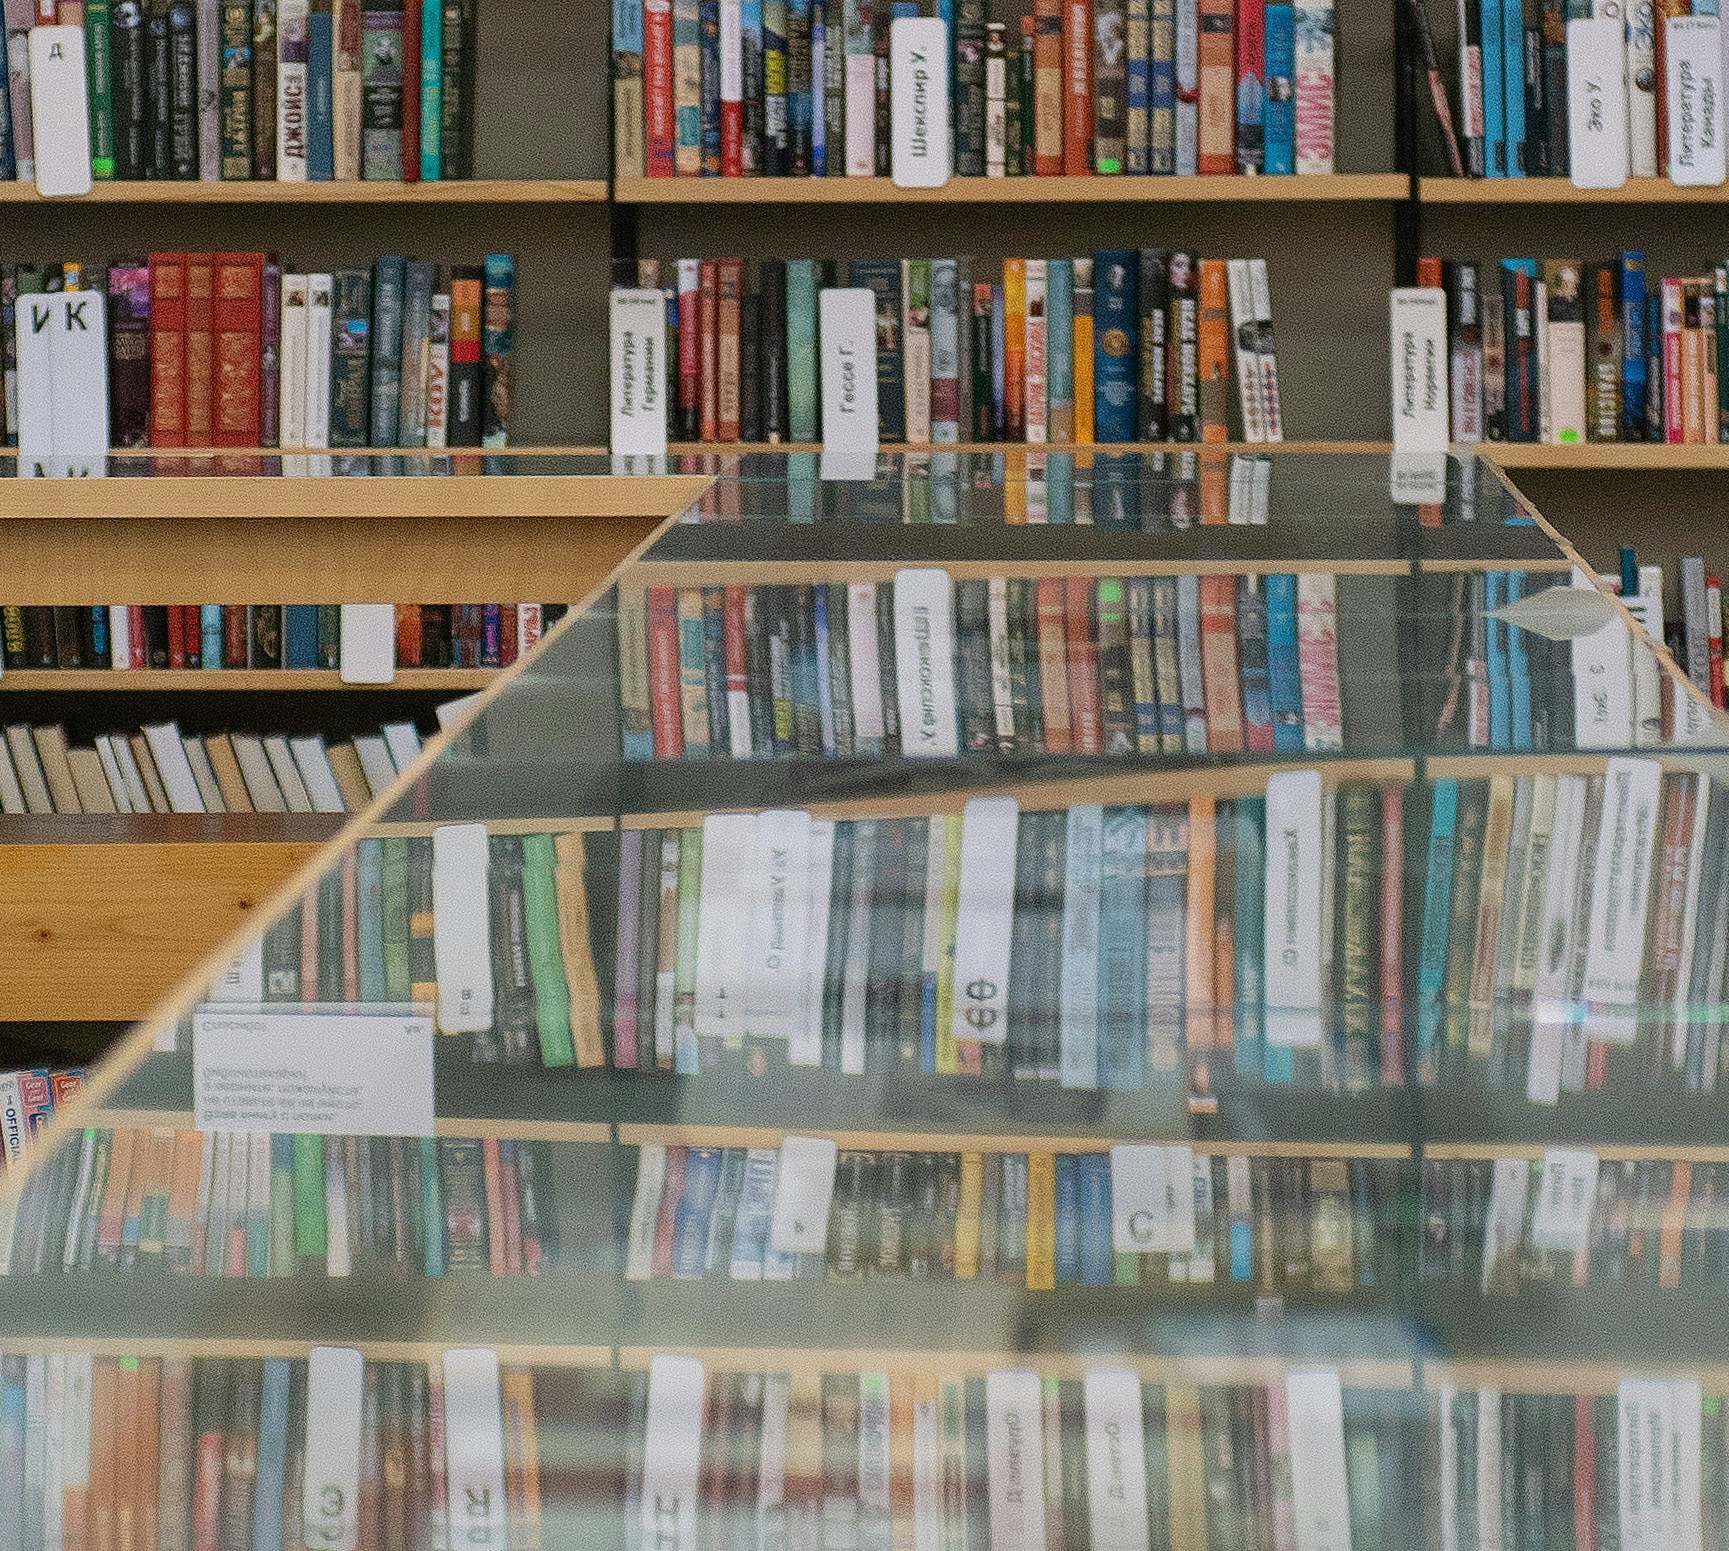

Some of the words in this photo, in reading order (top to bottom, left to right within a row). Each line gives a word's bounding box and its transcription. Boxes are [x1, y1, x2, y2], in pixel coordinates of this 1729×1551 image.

[48, 42, 65, 60] Д
[285, 85, 305, 159] ДЖОЙС
[912, 69, 930, 158] Шекспир
[1297, 72, 1335, 161] ЭМИС
[1587, 98, 1602, 130] Эко
[1678, 59, 1695, 166] Литература
[1700, 77, 1716, 149] Канады
[65, 301, 87, 331] К
[621, 330, 636, 415] Литература
[643, 336, 657, 410] Германии
[839, 361, 856, 414] Гессе
[1401, 331, 1416, 417] Литература
[1424, 338, 1438, 411] Норвегии
